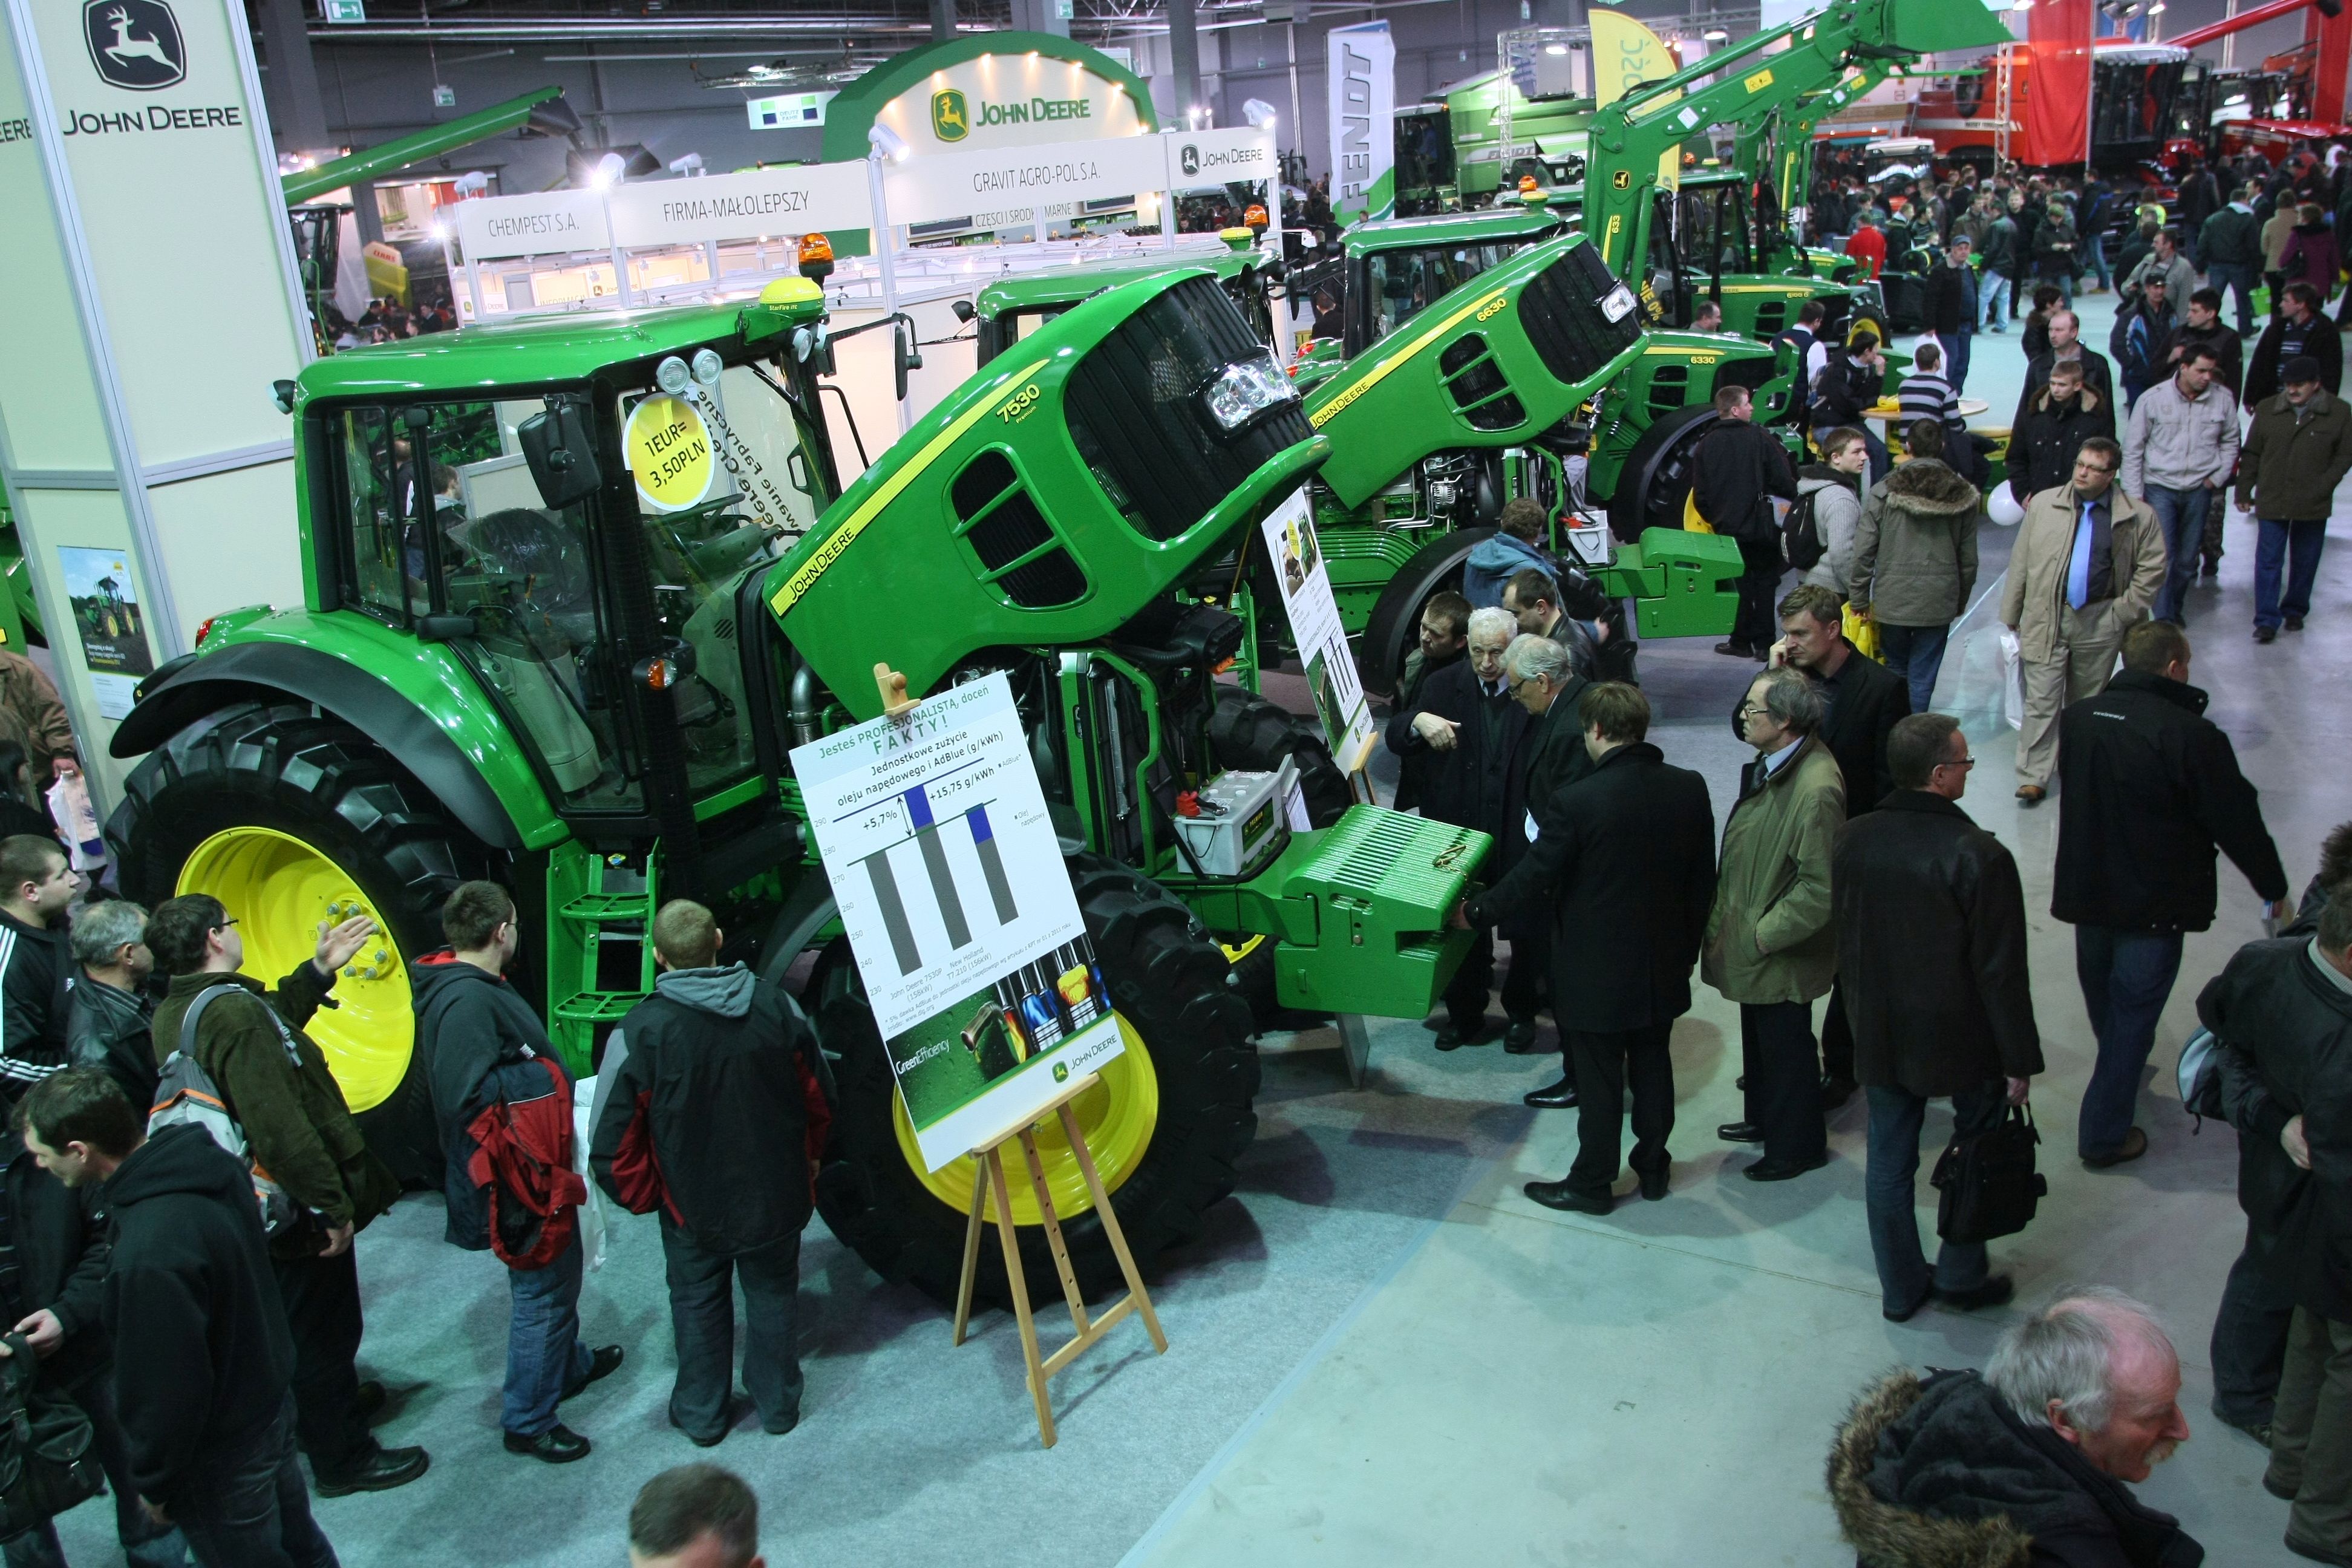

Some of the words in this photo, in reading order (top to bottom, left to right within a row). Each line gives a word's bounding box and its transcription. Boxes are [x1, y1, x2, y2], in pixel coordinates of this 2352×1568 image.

[63, 109, 145, 136] JOHN
[146, 106, 243, 131] DEERE
[976, 102, 1029, 126] JOHN
[1031, 98, 1091, 122] DEERE
[1342, 43, 1371, 214] FENDT
[1203, 151, 1230, 166] JOHN
[1231, 149, 1263, 163] DEERE
[973, 170, 1015, 192] GRAVIT
[1019, 164, 1078, 187] AGRO-POL
[1080, 162, 1101, 180] S.A.
[663, 191, 809, 222] FIRMA-MAŁOLEPSZY
[1045, 203, 1072, 218] MARNE
[488, 215, 552, 237] CHEMPEST
[555, 213, 580, 231] S.A.
[1612, 215, 1620, 234] 633
[1640, 281, 1655, 304] NIE
[1476, 298, 1506, 322] 6630
[1647, 301, 1664, 321] 0%
[1690, 356, 1715, 364] 6330
[996, 384, 1040, 423] 7530
[1312, 405, 1338, 428] JOHN
[1336, 382, 1368, 408] DEERE
[650, 438, 706, 488] 3,50PLN
[789, 564, 820, 601] JOHN
[815, 528, 855, 569] DEERE
[819, 736, 856, 759] Jesteś
[961, 685, 989, 704] doceń
[871, 745, 933, 776] Jednostkowe
[936, 730, 968, 751] zużycie
[838, 791, 863, 806] oleju
[866, 765, 927, 796] napędowego
[934, 747, 965, 767] AdBlue
[967, 730, 1004, 756] (g/kWh)
[930, 780, 962, 802] +15,75
[965, 766, 995, 788] g/kWh
[814, 817, 827, 828] 290
[863, 809, 898, 832] +5,7%
[823, 845, 836, 856] 280
[832, 874, 845, 884] 270
[841, 901, 854, 913] 260
[851, 929, 864, 941] 250
[860, 957, 873, 969] 240
[950, 958, 962, 969] New
[963, 946, 984, 962] Holland
[869, 985, 883, 996] 230
[890, 988, 906, 1001] John
[906, 979, 924, 991] Deere
[895, 1039, 950, 1075] GreenEfficiency
[1071, 1051, 1093, 1070] JOHN
[1091, 1034, 1117, 1057] DEERE
